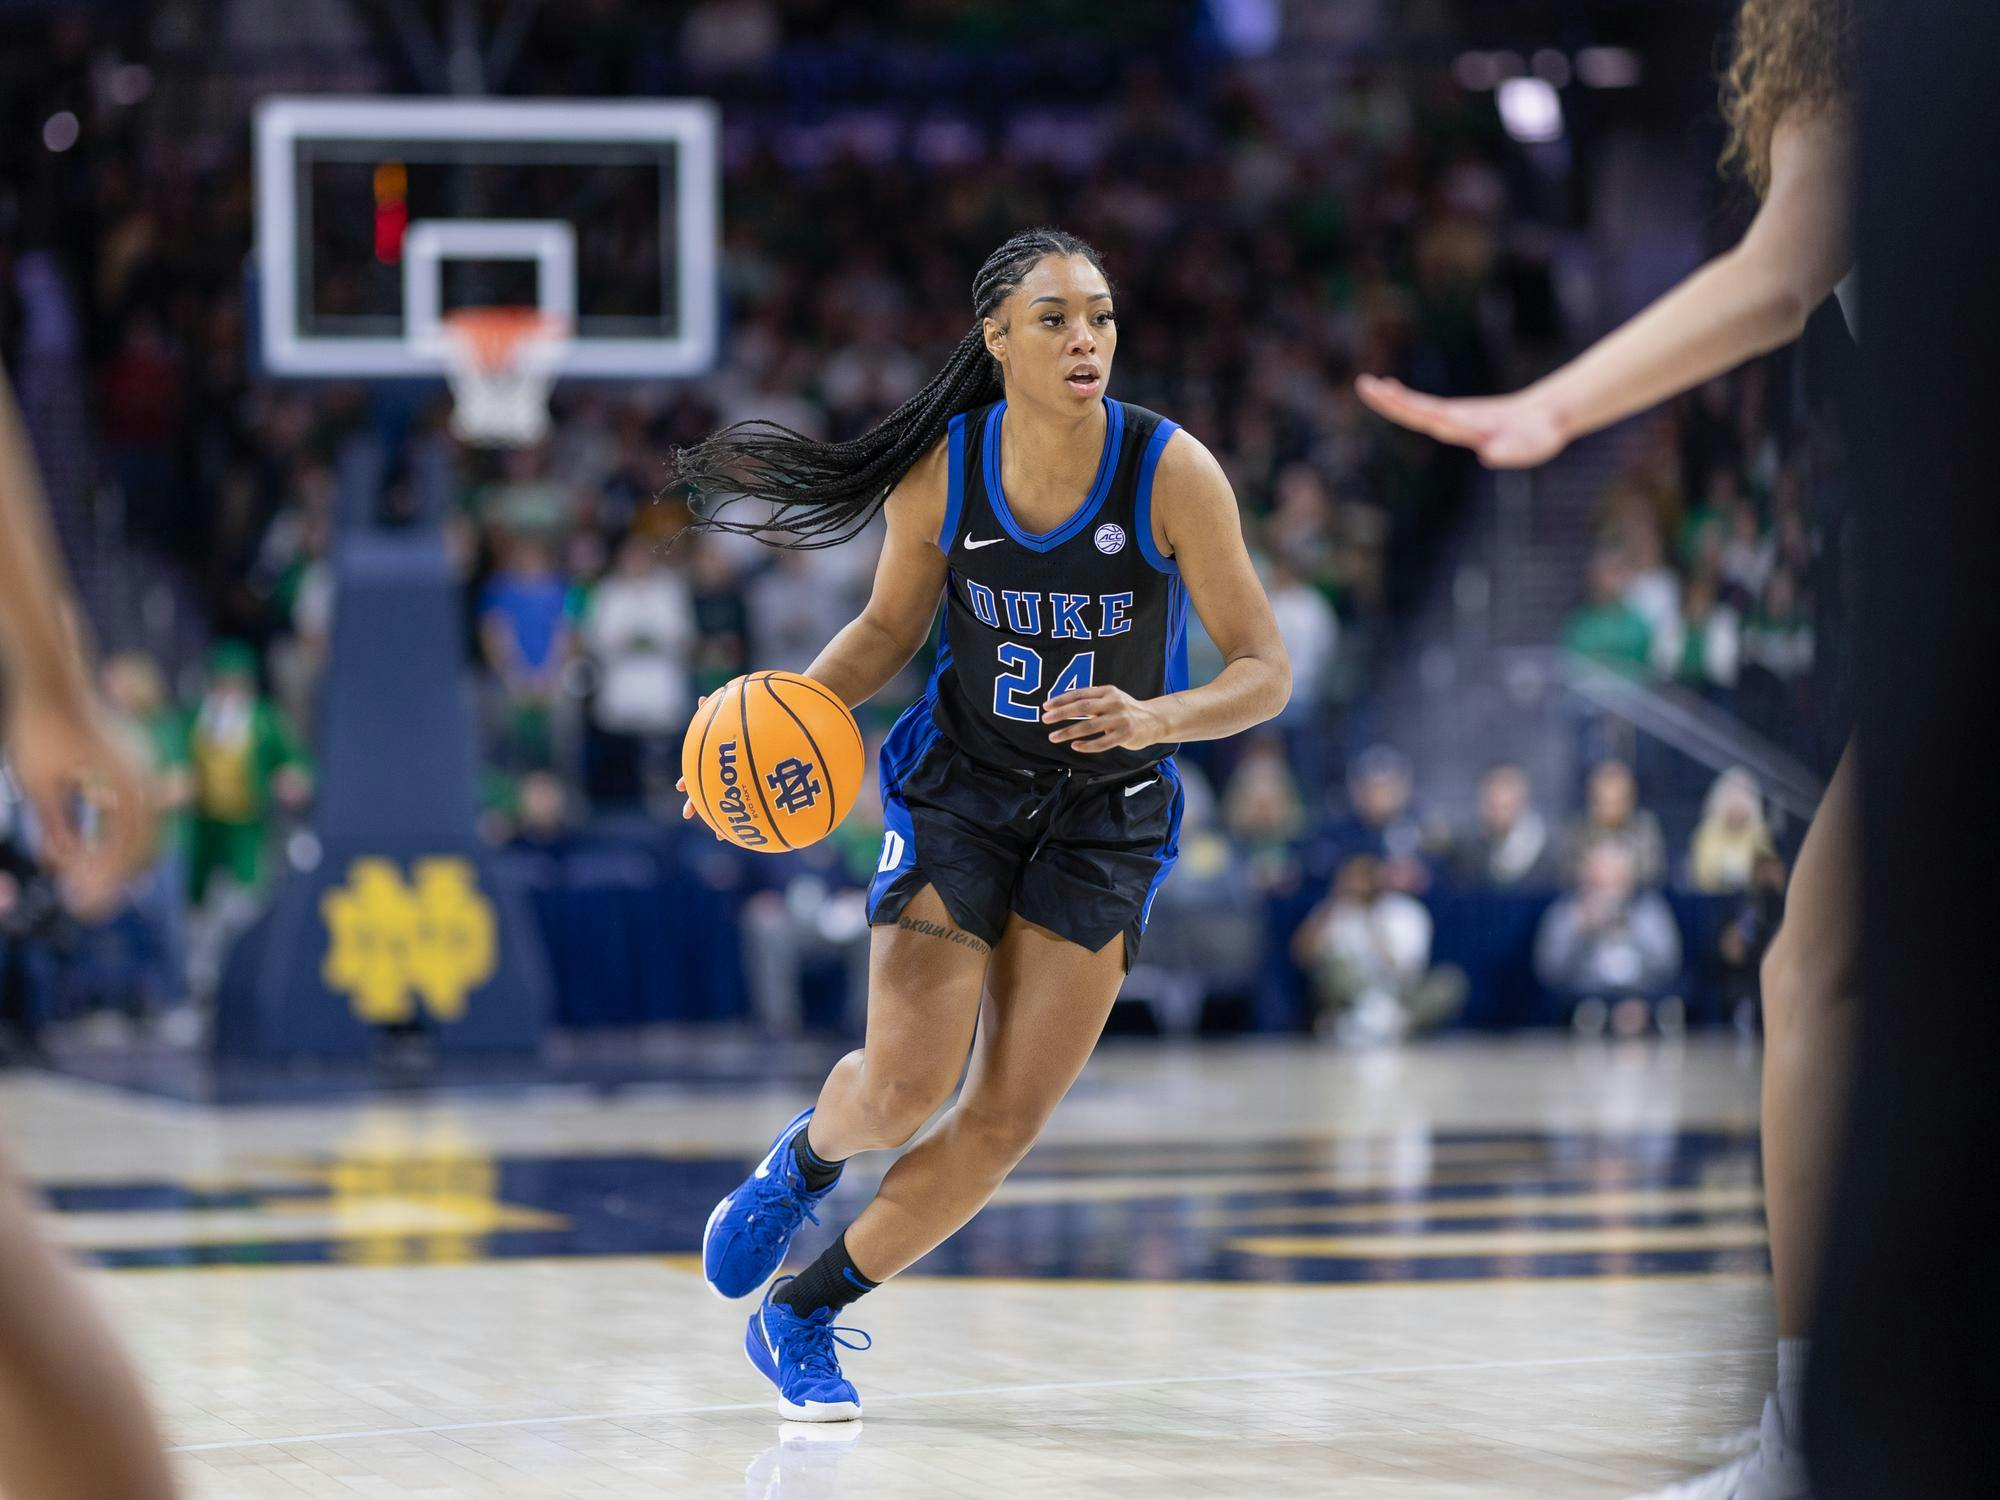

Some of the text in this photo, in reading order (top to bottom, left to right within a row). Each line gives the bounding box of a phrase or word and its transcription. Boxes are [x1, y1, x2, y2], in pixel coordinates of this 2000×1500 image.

[1099, 533, 1122, 541] ACC
[966, 579, 1133, 640] DUKE
[993, 641, 1095, 723] 24
[719, 740, 768, 846] Wilson
[878, 830, 906, 873] D
